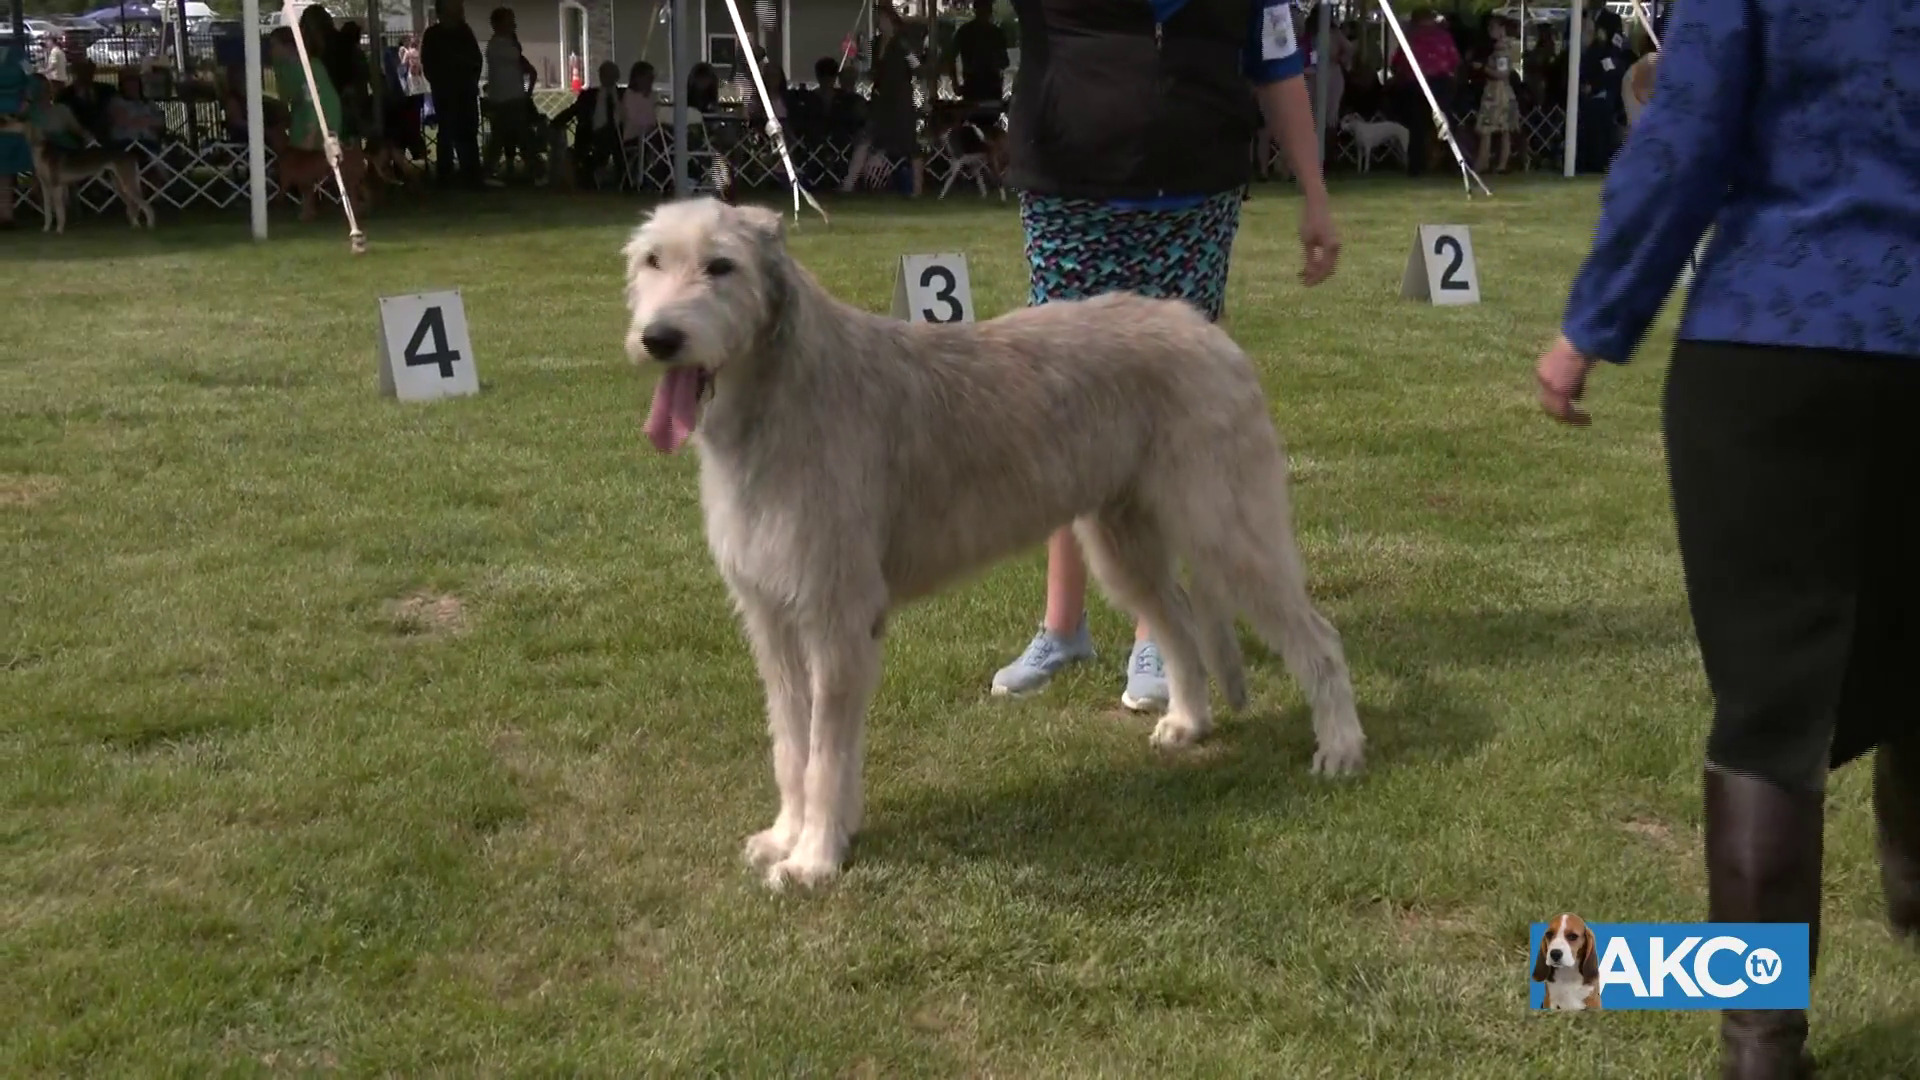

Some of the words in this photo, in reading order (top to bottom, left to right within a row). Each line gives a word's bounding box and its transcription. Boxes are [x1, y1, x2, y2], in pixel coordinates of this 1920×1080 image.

[1434, 234, 1470, 290] 2
[920, 265, 963, 323] 3
[404, 306, 461, 378] 4
